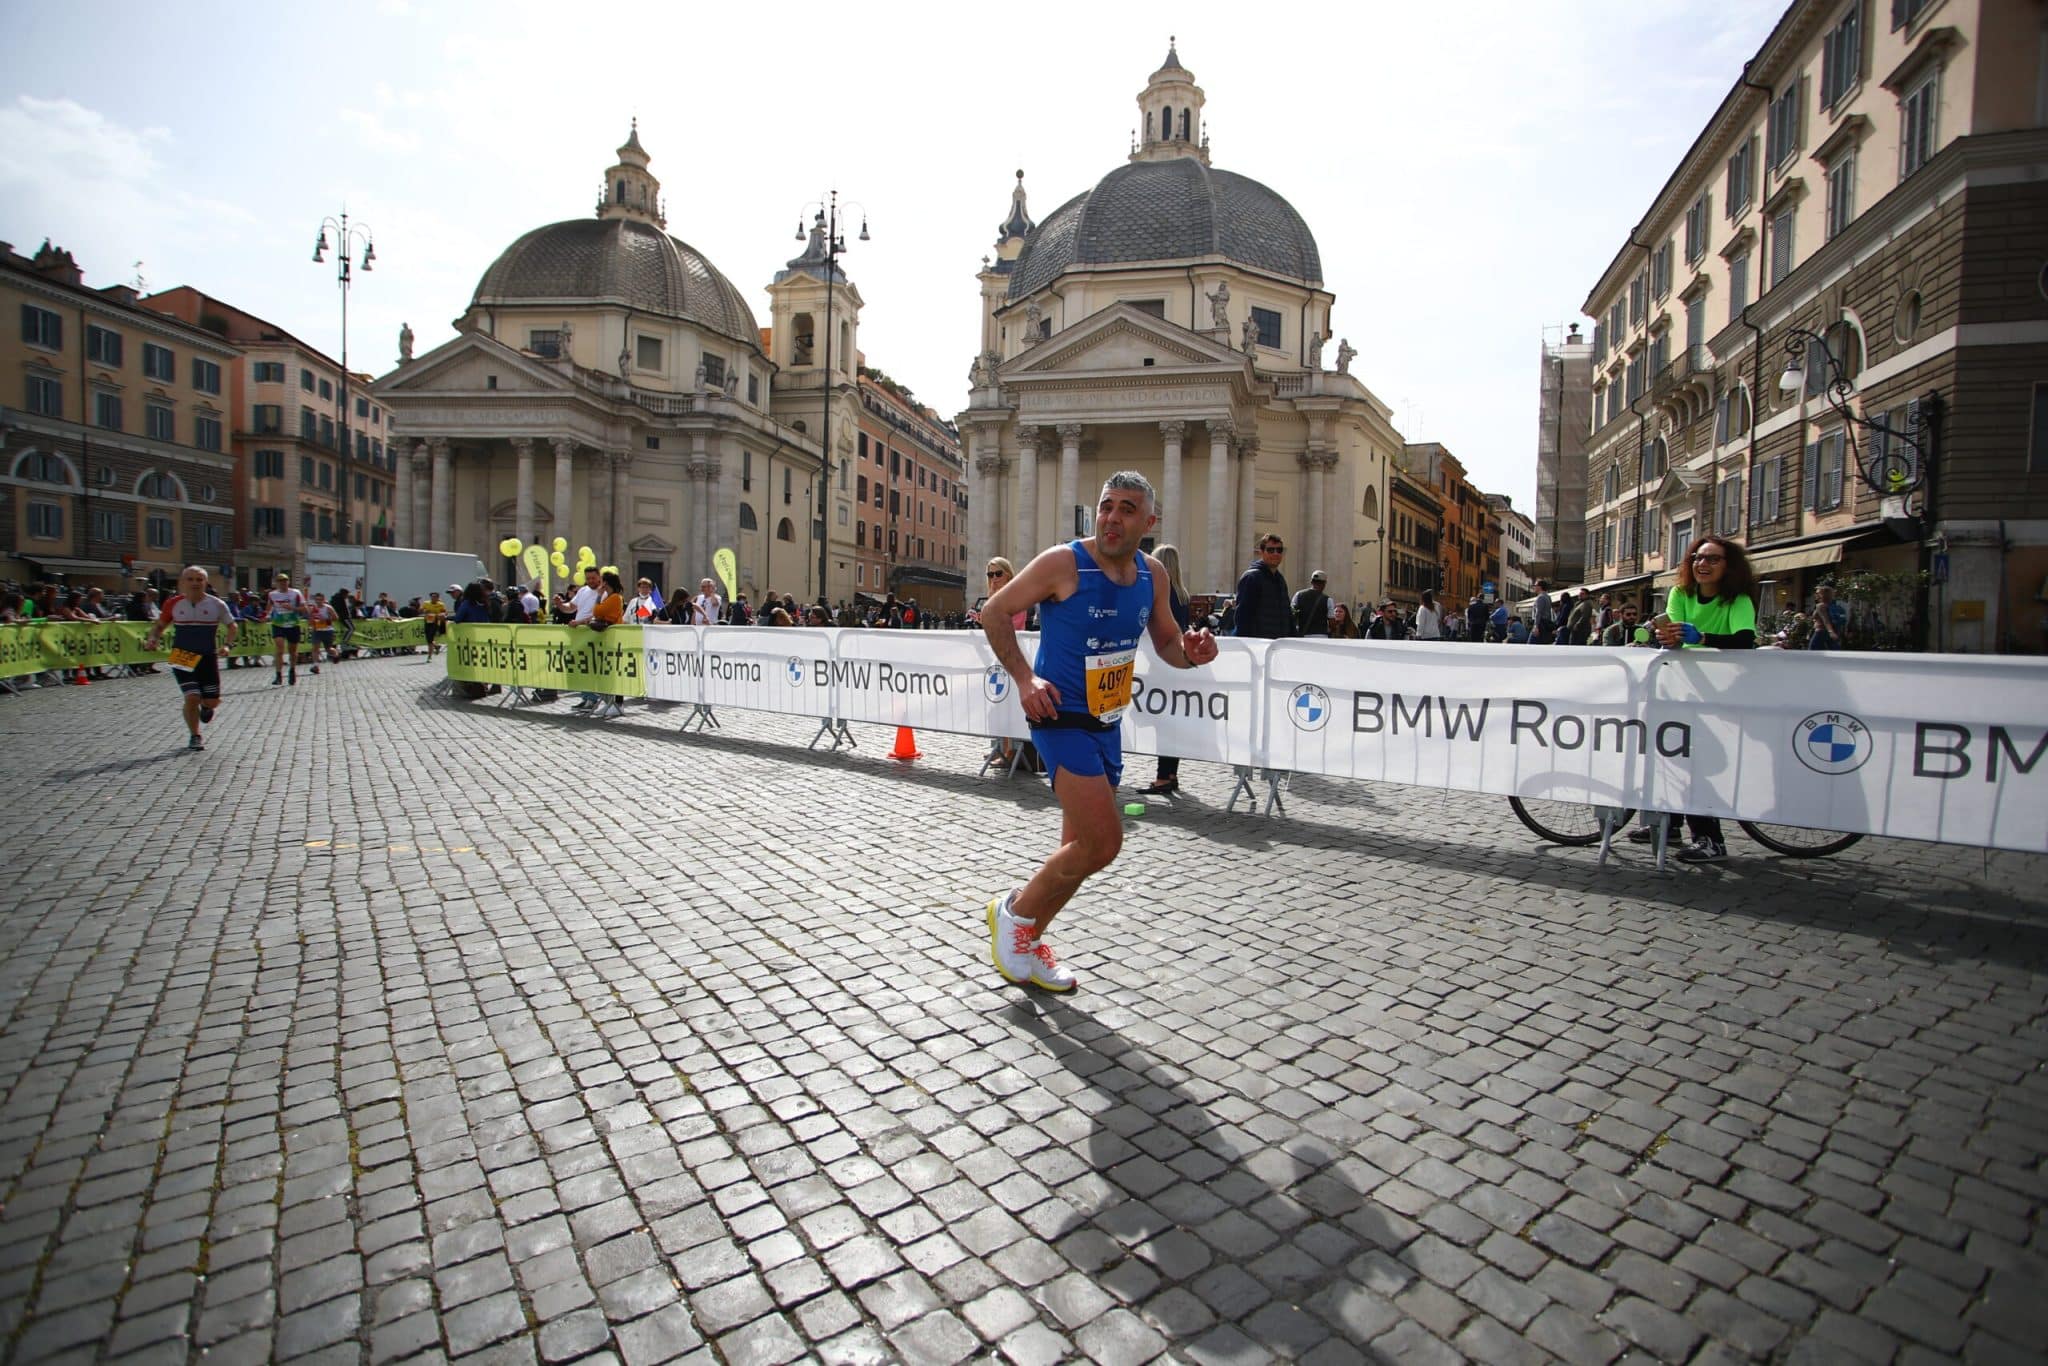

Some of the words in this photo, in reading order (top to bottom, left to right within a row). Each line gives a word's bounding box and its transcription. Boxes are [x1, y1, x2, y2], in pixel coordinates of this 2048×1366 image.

[456, 638, 527, 671] idealista
[545, 641, 637, 678] idealista
[665, 652, 705, 678] BMW
[710, 655, 761, 682] Roma
[814, 659, 871, 690] BMW
[879, 662, 949, 696] Roma
[1098, 665, 1129, 691] 4097
[1131, 676, 1229, 721] Roma
[1352, 691, 1490, 742] BMW
[1510, 699, 1691, 758] Roma
[1803, 714, 1863, 734] BMW
